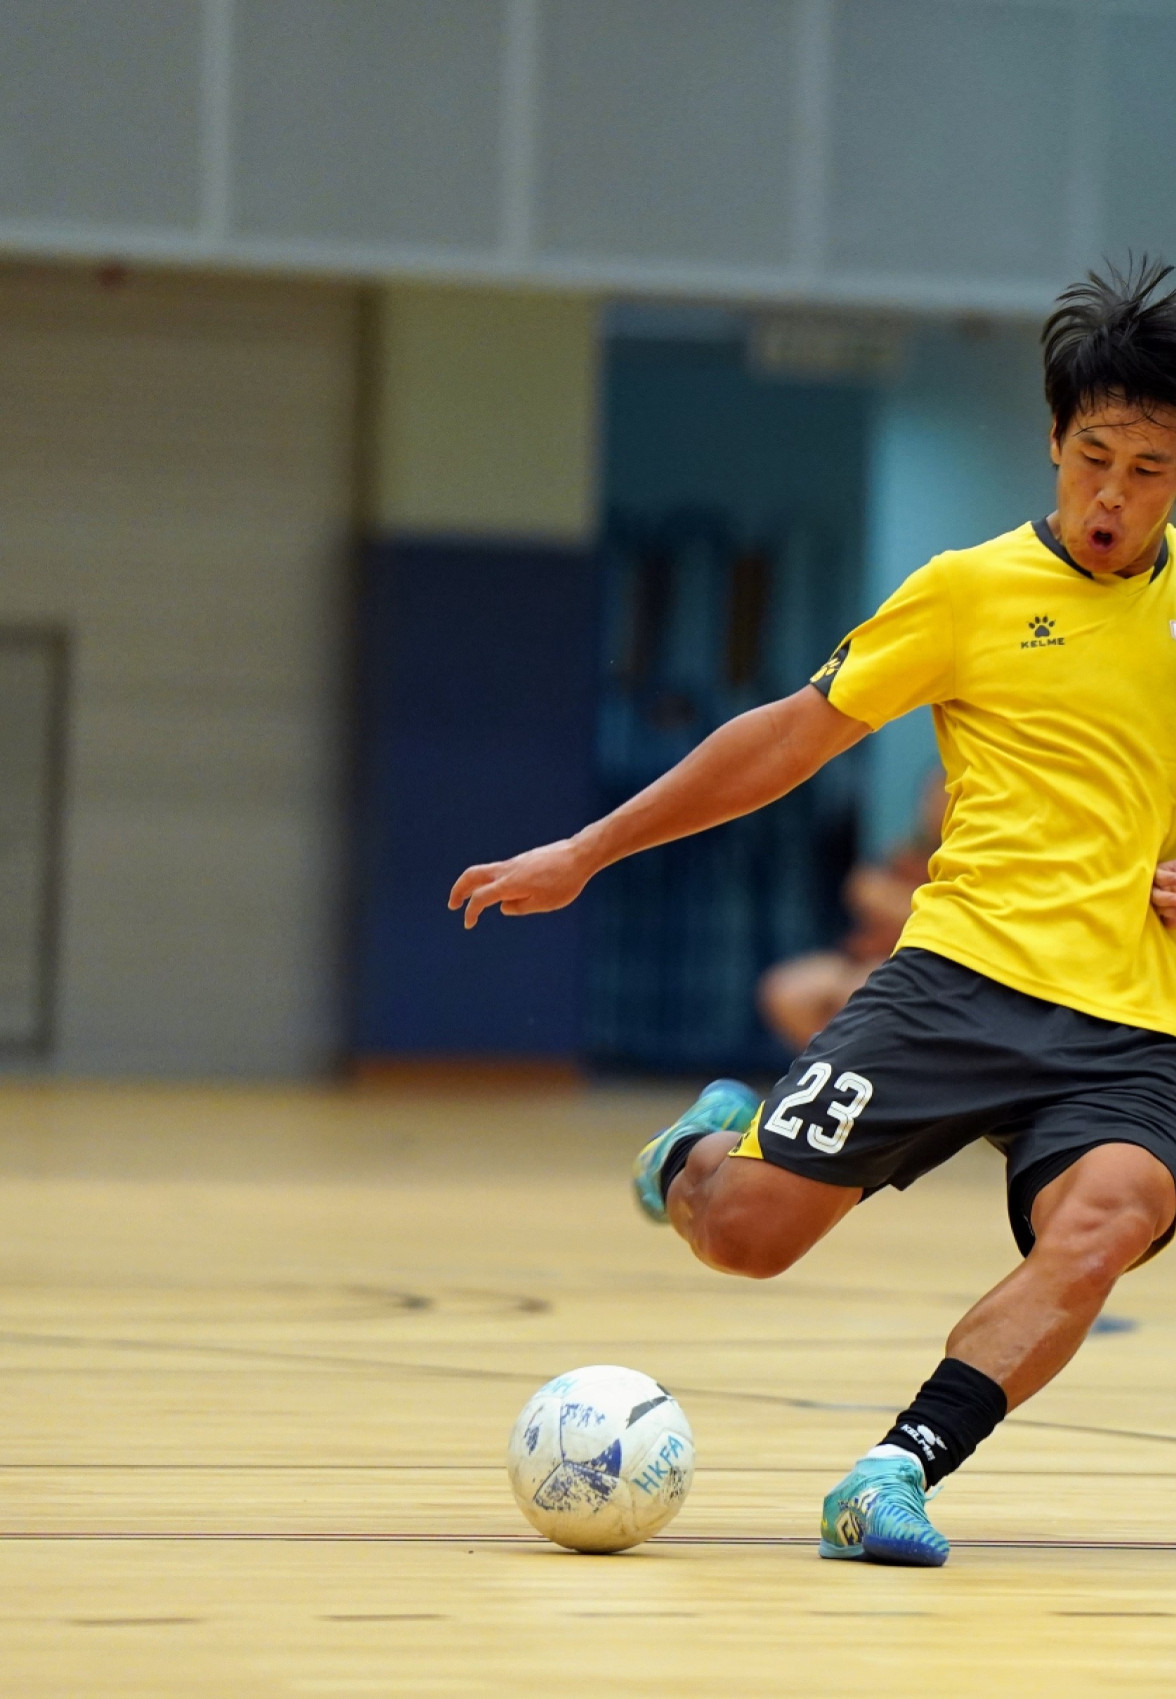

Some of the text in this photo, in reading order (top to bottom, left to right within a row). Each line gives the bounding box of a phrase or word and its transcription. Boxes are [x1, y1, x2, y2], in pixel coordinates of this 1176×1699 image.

[1020, 637, 1065, 649] KELME
[764, 1061, 873, 1154] 23
[631, 1434, 685, 1495] HKFA
